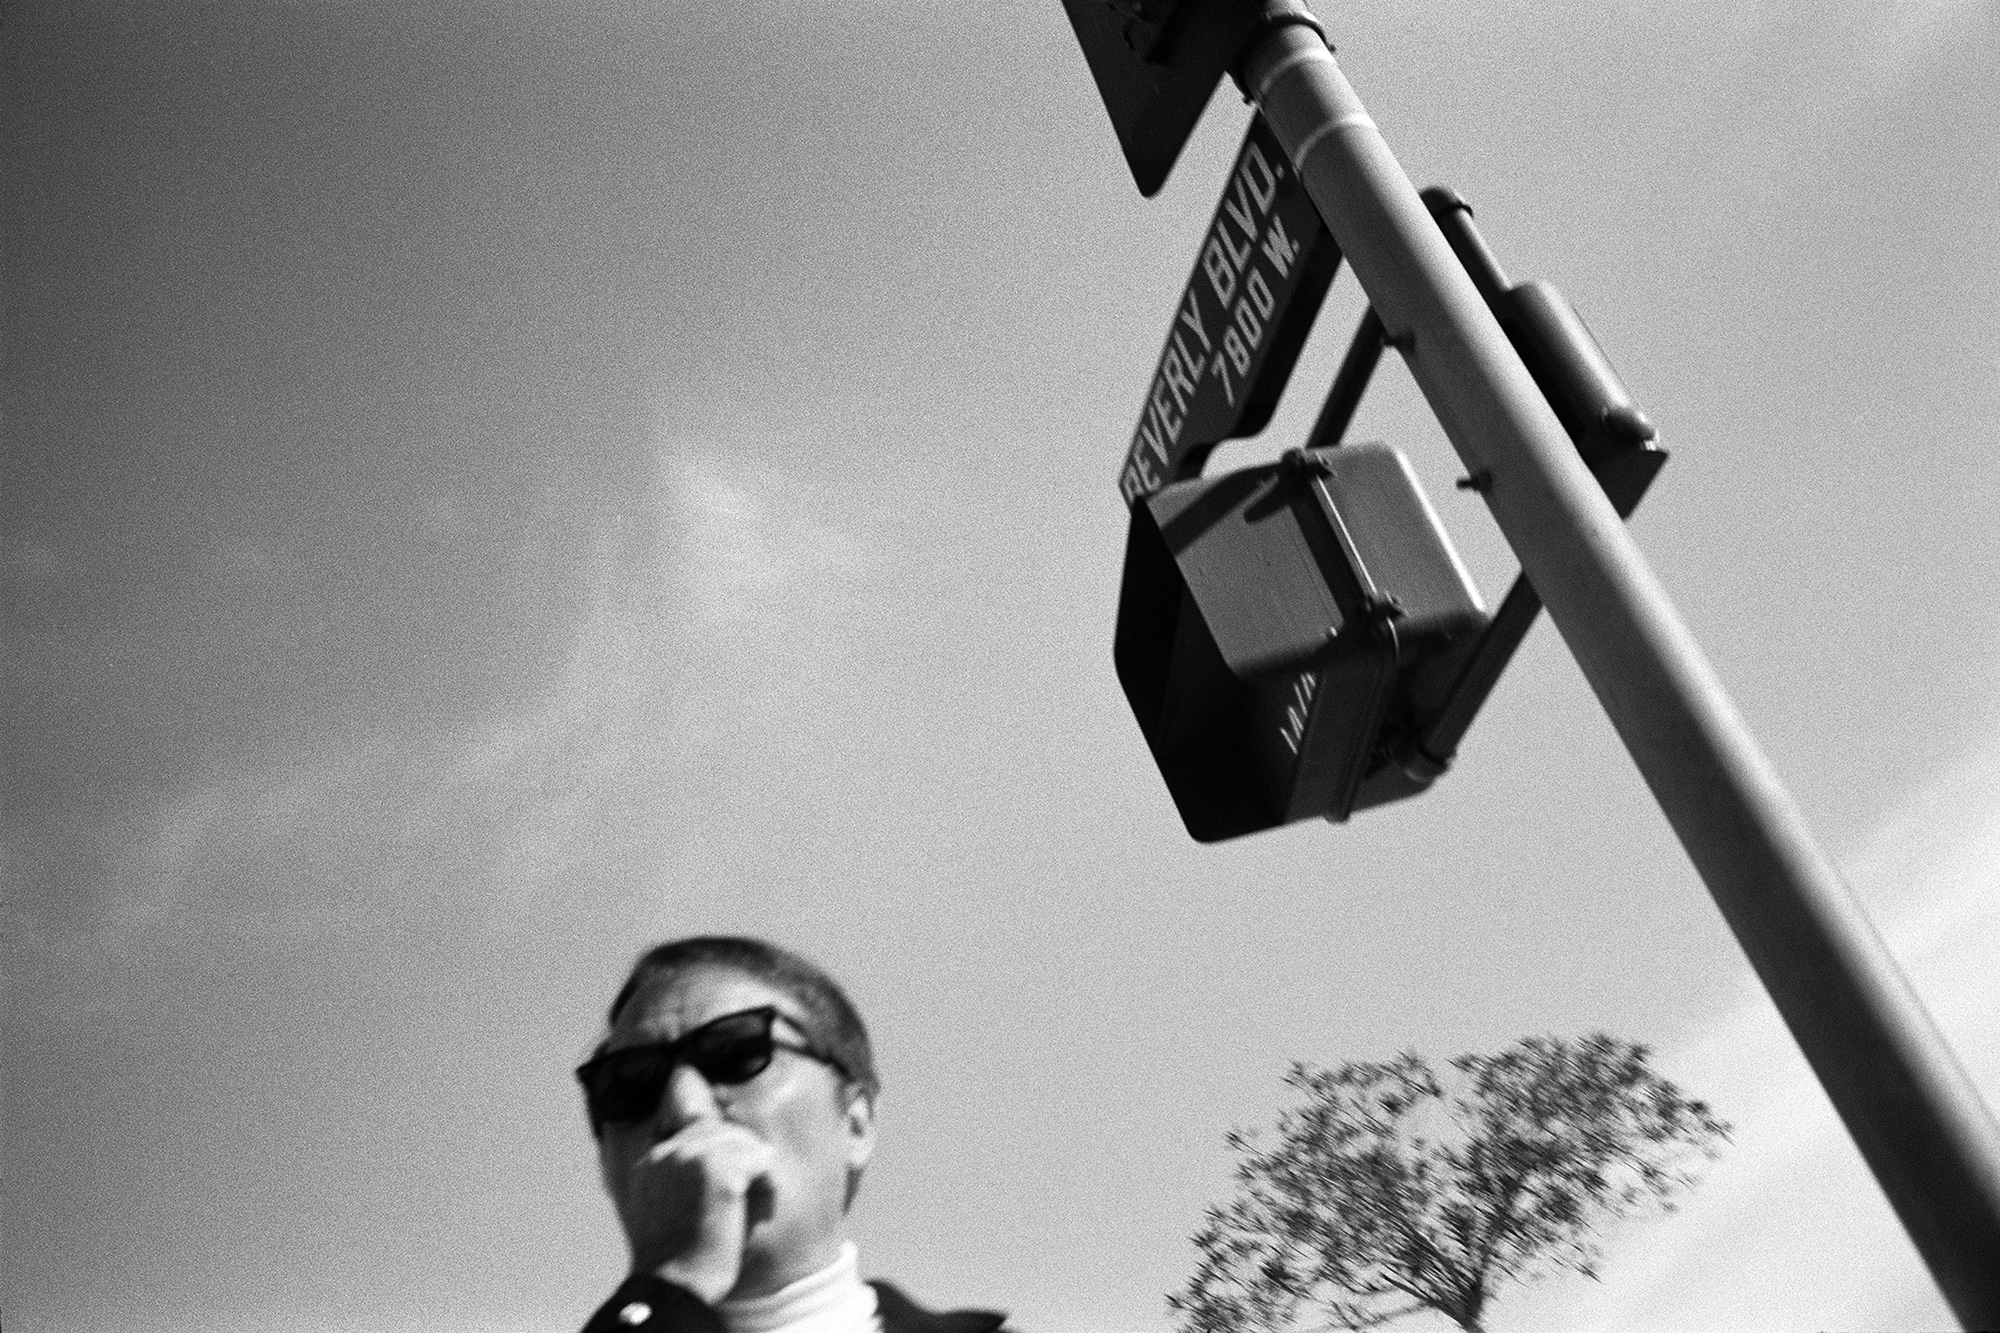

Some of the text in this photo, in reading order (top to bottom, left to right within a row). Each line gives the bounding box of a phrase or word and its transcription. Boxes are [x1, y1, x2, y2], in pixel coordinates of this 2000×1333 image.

[1123, 140, 1285, 503] BEVERLY BLVD.
[1212, 212, 1300, 406] 7800 W.
